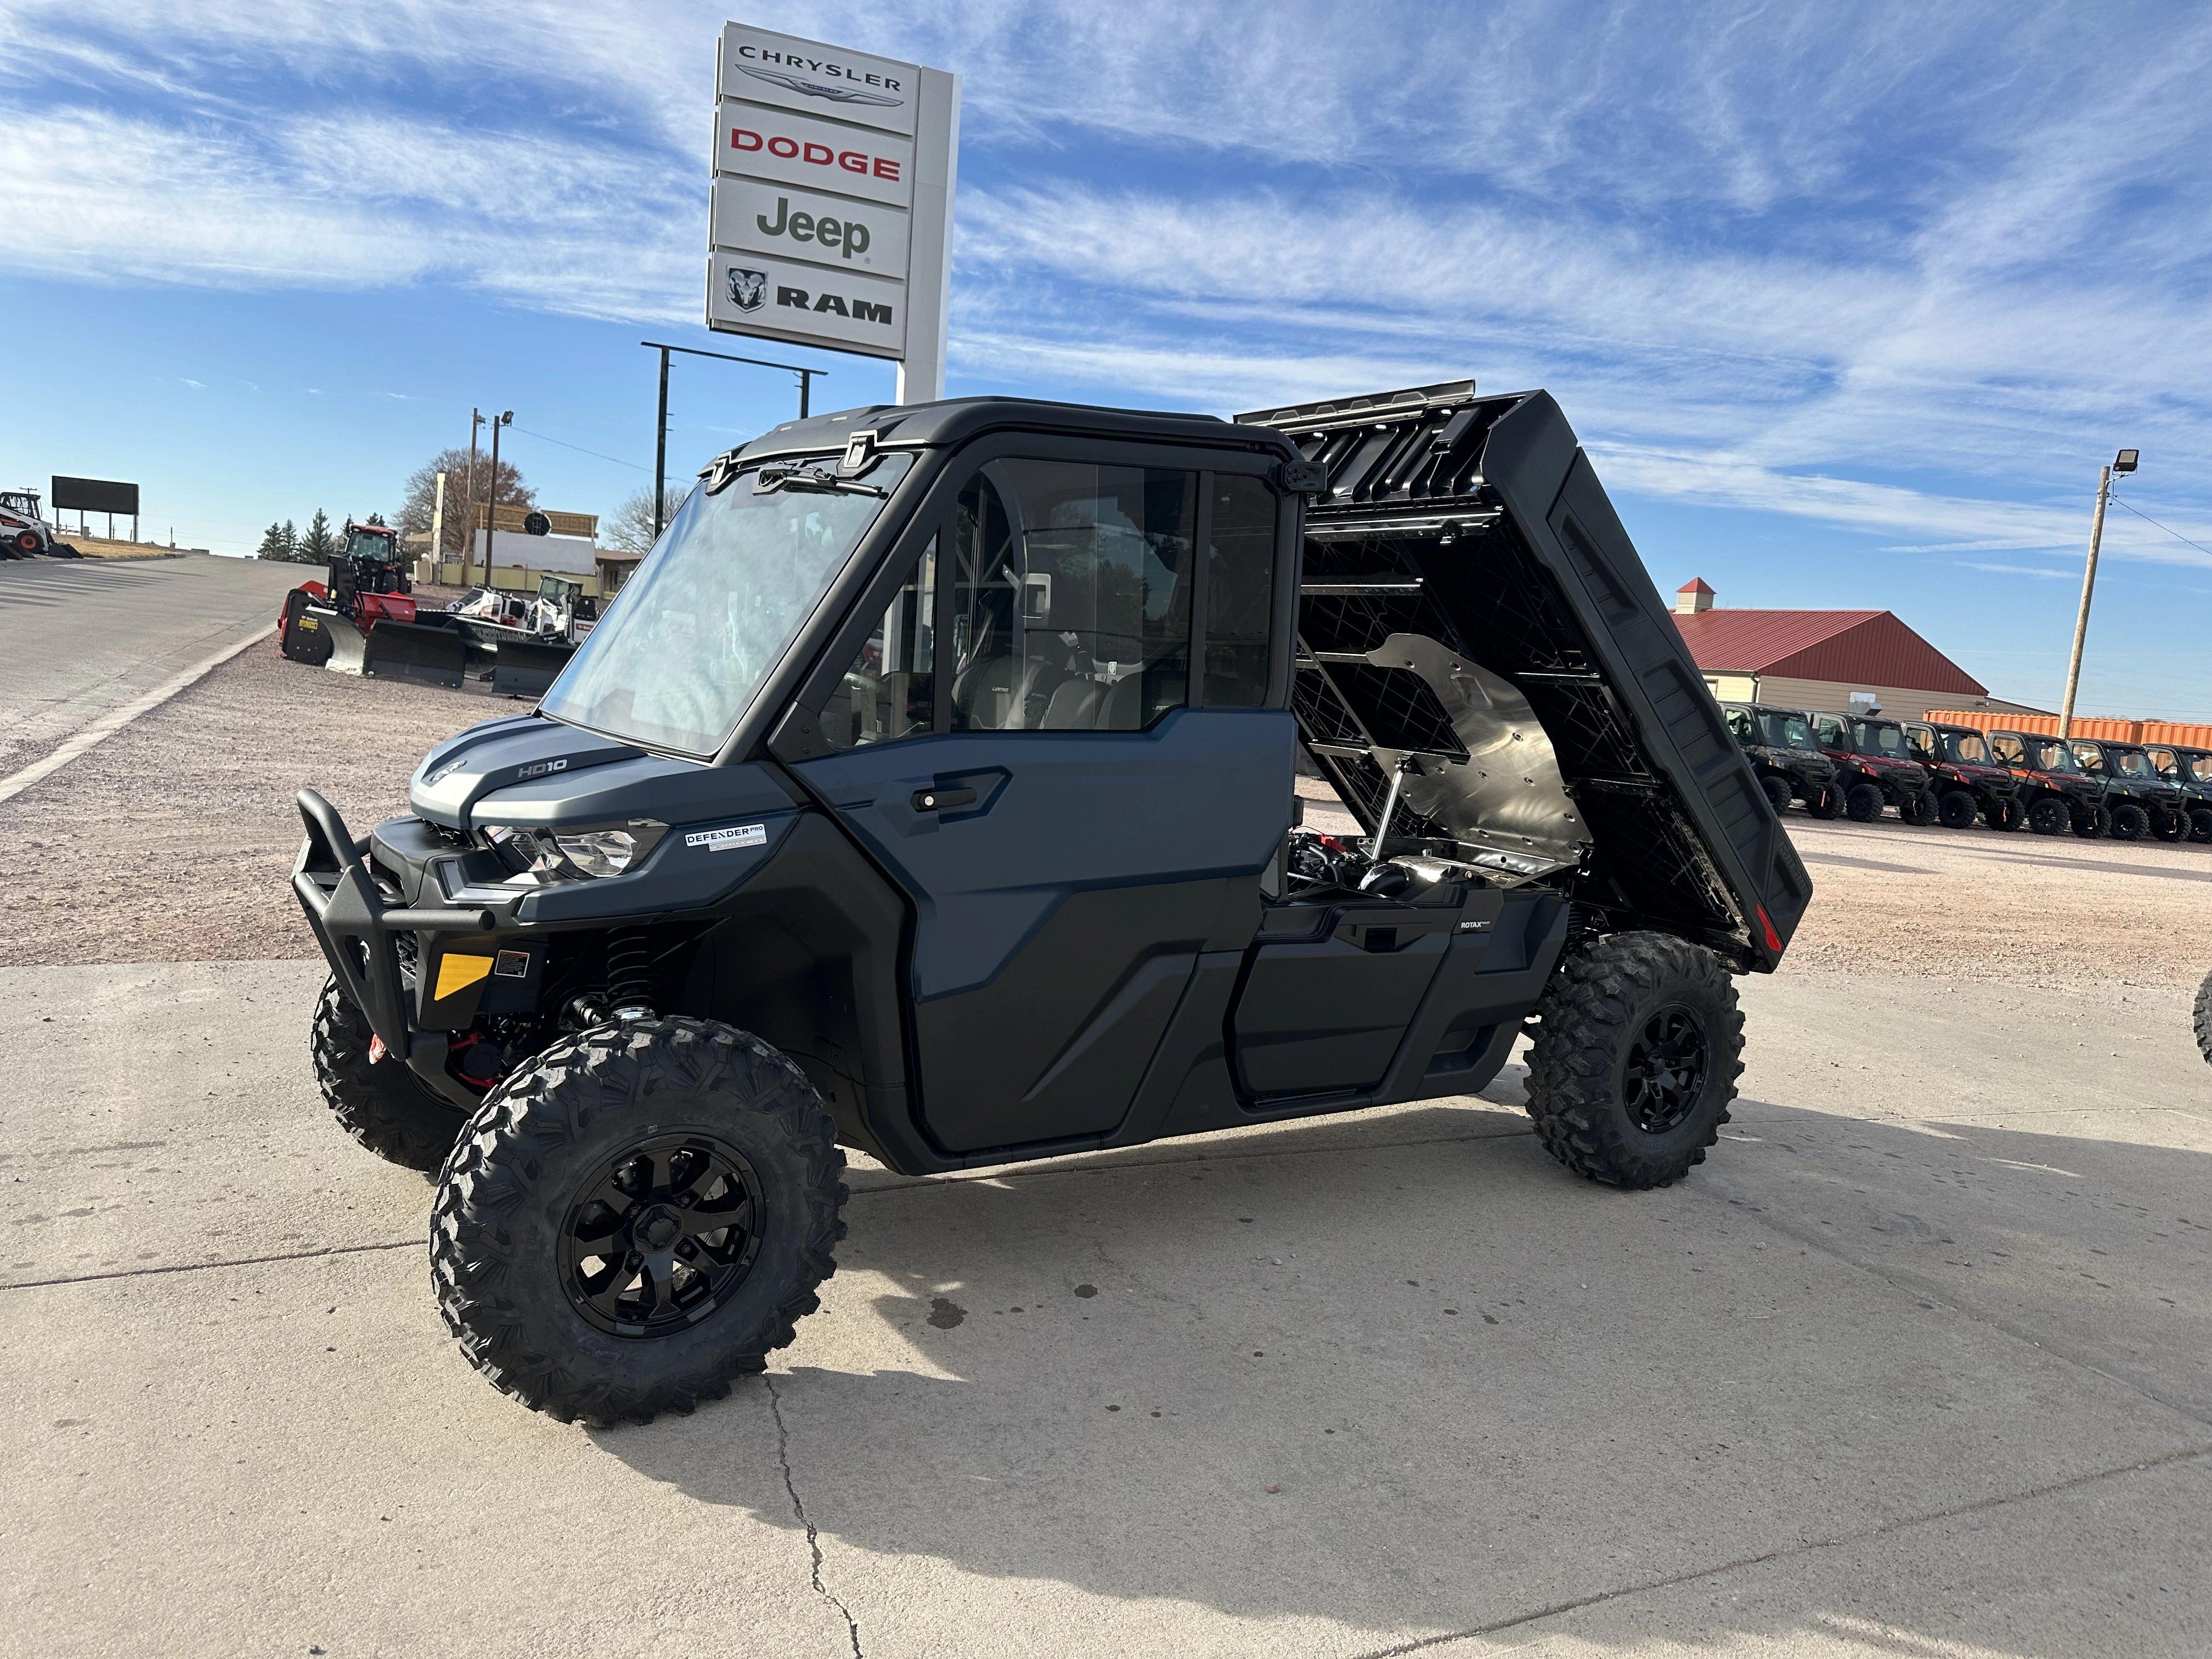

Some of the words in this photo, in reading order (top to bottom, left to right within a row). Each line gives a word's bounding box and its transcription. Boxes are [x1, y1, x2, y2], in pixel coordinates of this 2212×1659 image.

[738, 46, 901, 92] CHRYSLER
[731, 128, 900, 182] DODGE
[757, 197, 870, 259] Jeep
[777, 285, 893, 325] RAM
[518, 759, 568, 778] HD10
[687, 828, 749, 843] DEFENDER
